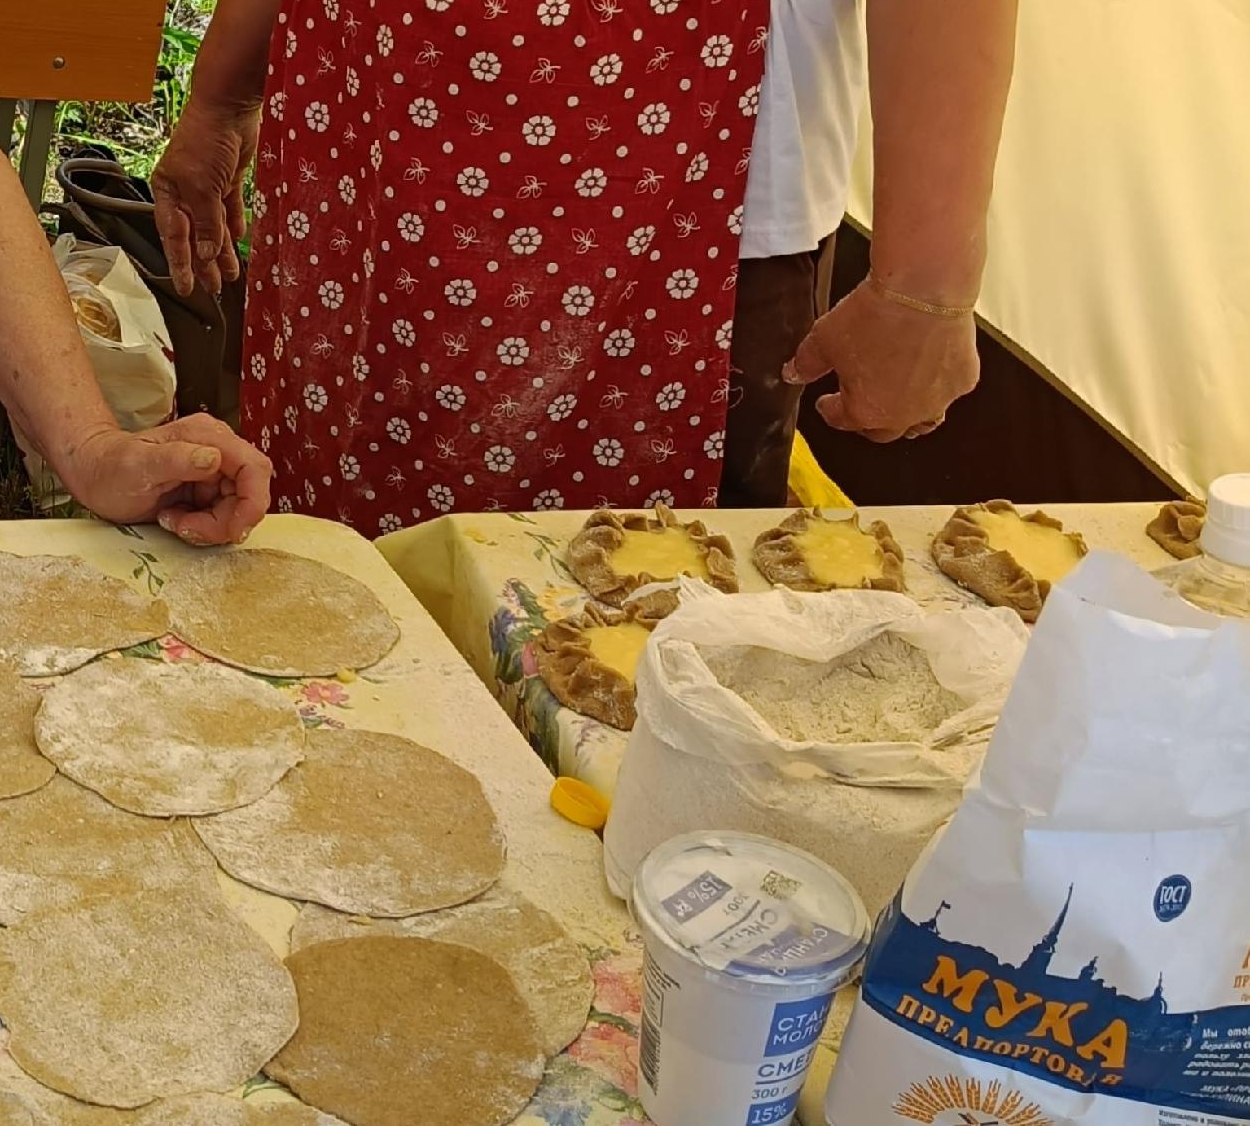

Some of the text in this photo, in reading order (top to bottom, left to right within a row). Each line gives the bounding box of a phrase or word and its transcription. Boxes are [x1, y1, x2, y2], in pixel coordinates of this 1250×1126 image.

[1160, 885, 1187, 904] ГОСТ
[922, 955, 1128, 1069] МУКА
[751, 1087, 780, 1100] 300
[751, 1102, 787, 1124] 15%
